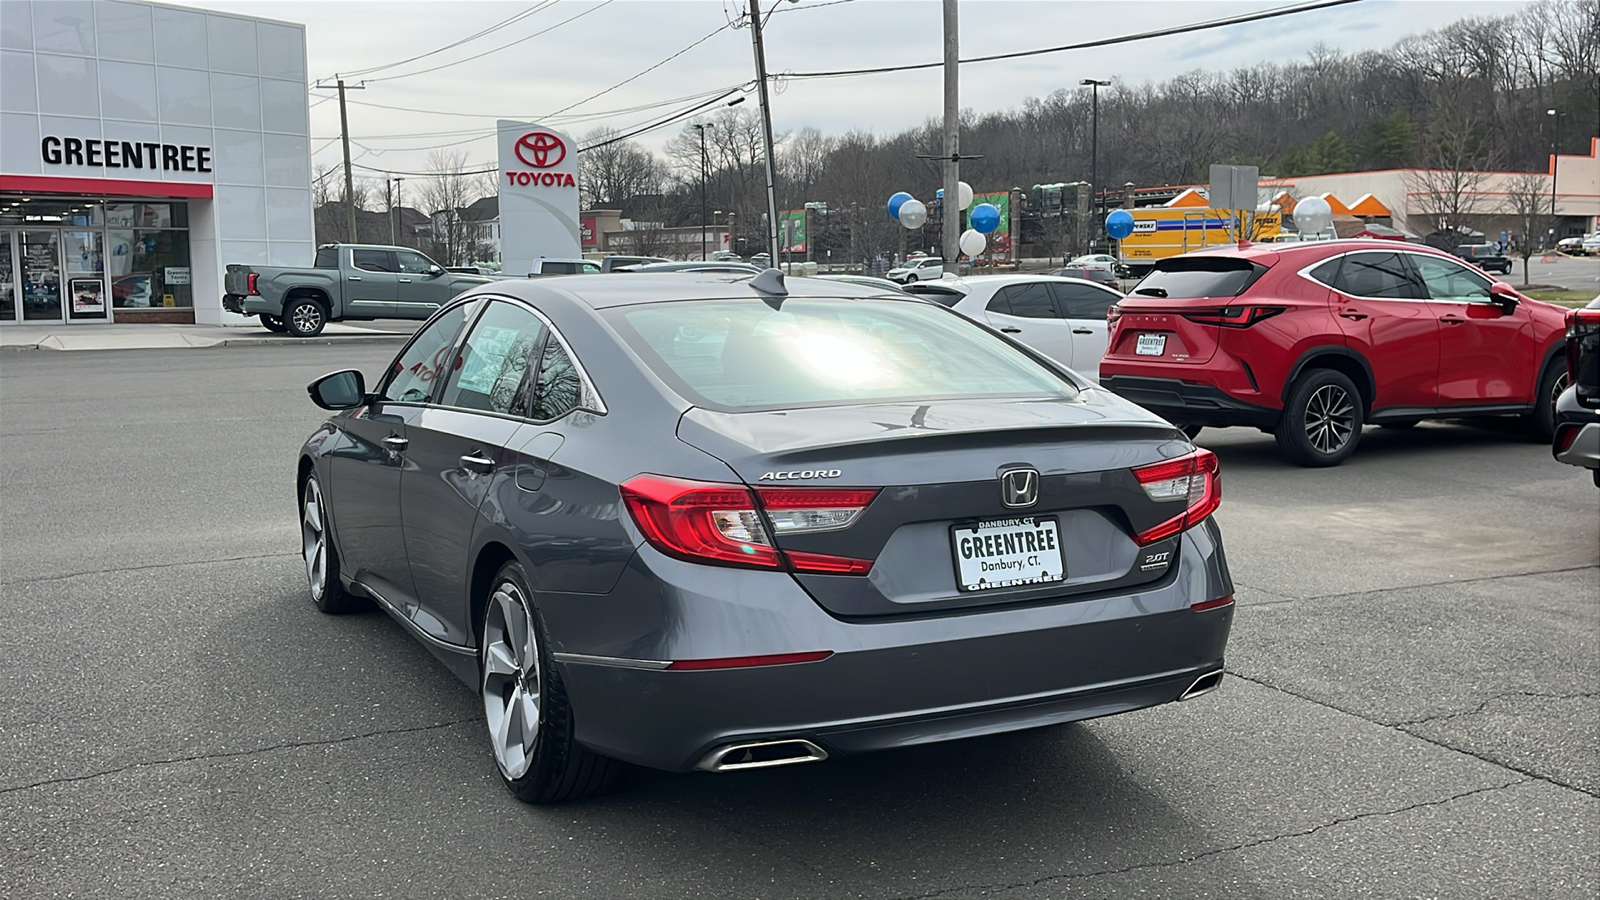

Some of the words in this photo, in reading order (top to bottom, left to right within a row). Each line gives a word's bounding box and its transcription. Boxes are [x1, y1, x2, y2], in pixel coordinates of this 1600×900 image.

[42, 137, 212, 172] GREENTREE
[505, 171, 576, 187] TOYOTA
[759, 469, 842, 481] ACCORD
[979, 519, 1022, 529] DANBURY,
[1023, 516, 1035, 526] CT
[961, 529, 1055, 559] GREENTREE
[981, 558, 1026, 573] Danbury,
[1027, 555, 1041, 567] CT.
[968, 575, 1062, 591] GREENTREE
